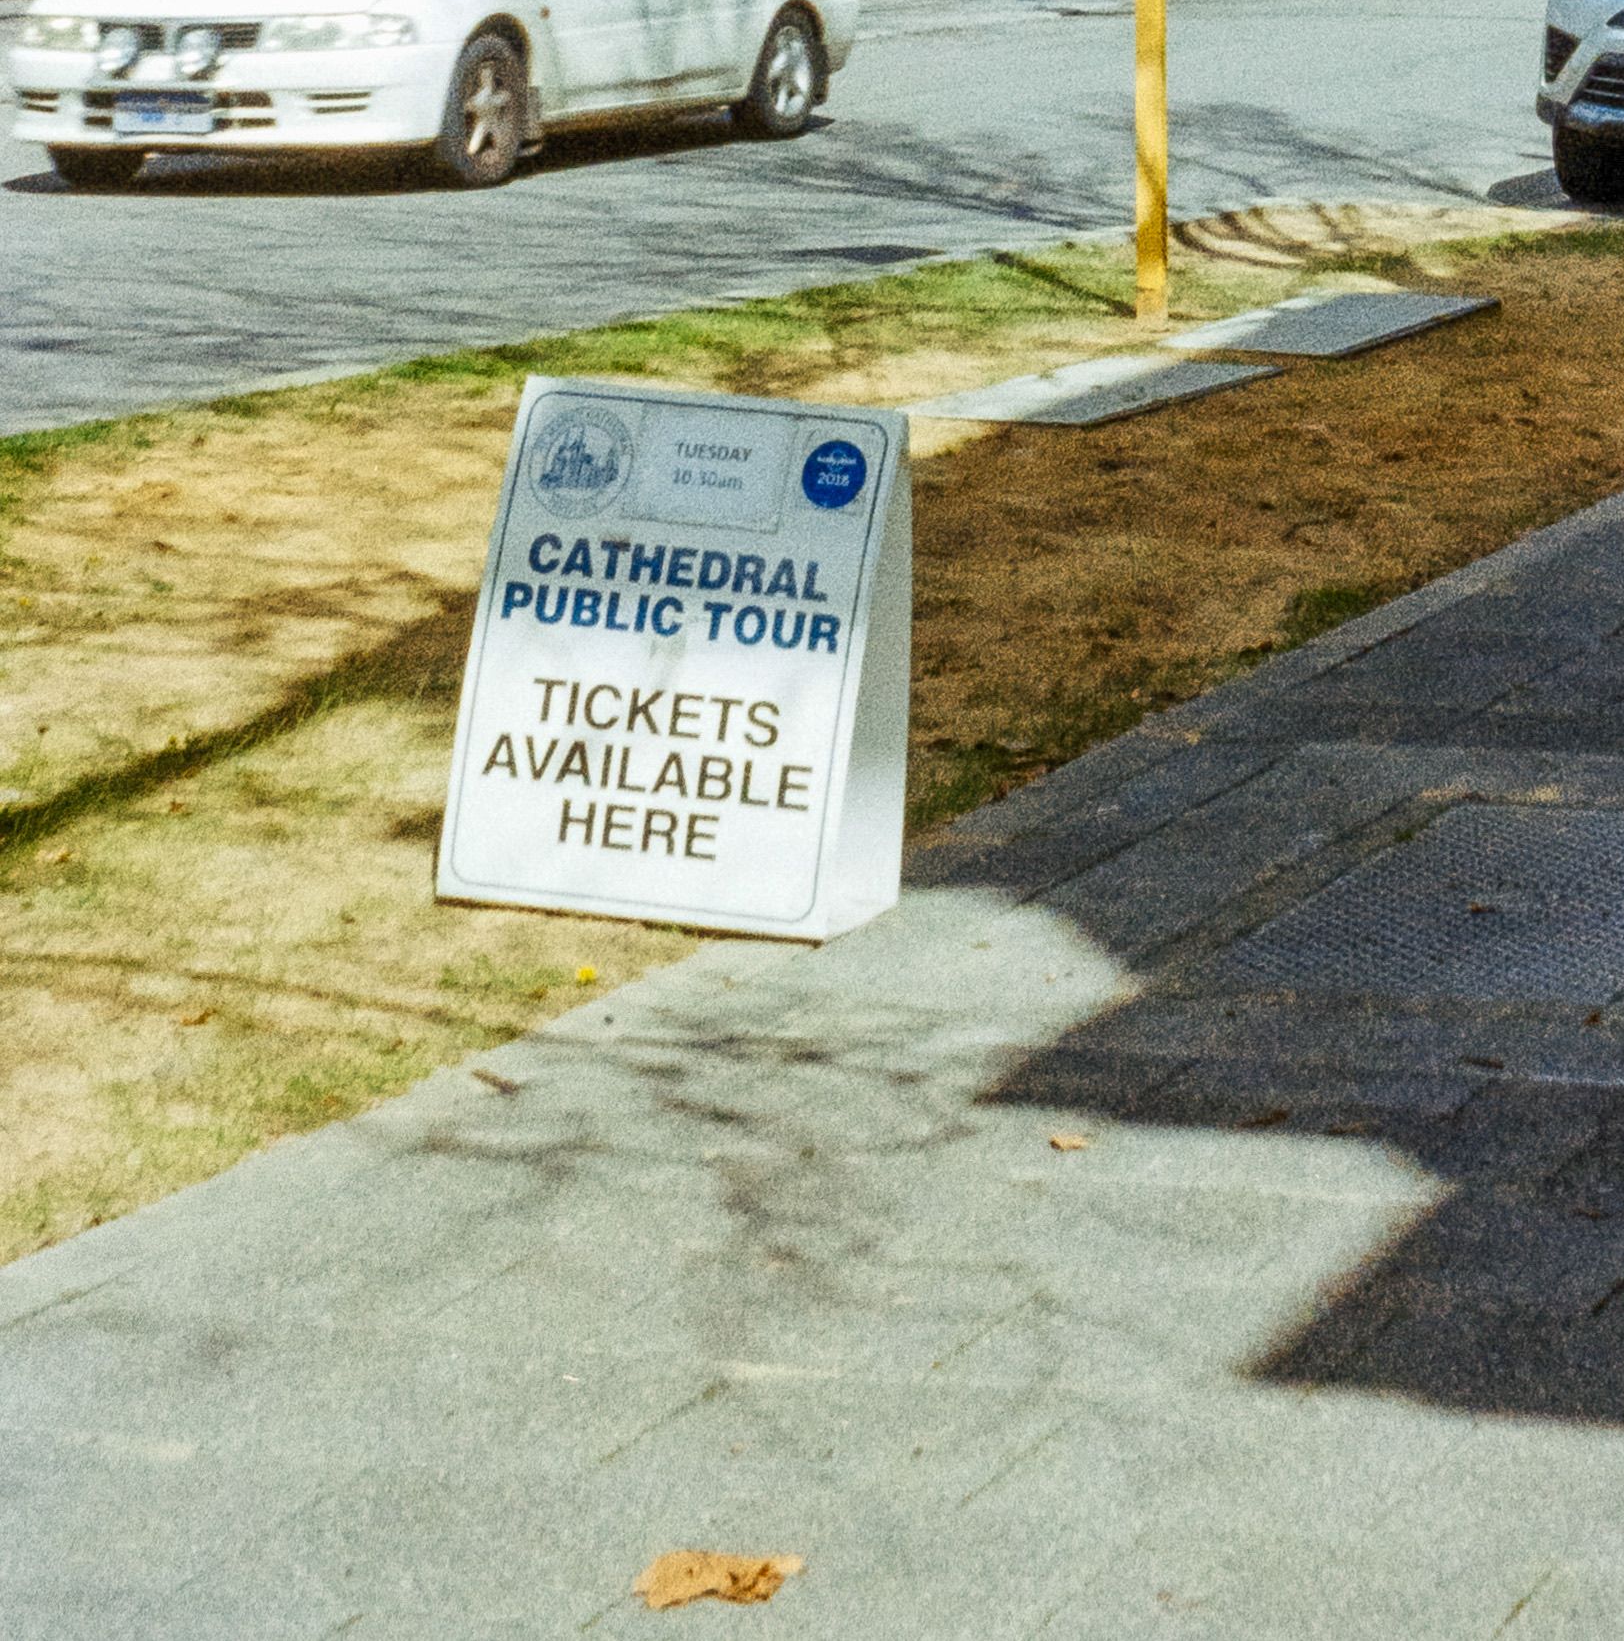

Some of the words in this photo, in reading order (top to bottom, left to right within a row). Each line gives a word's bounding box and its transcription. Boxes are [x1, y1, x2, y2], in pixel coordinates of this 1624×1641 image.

[675, 440, 752, 463] TUESDAY
[528, 533, 828, 602] CATHEDRAL
[500, 581, 684, 637] PUBLIC
[703, 601, 841, 654] TOUR
[533, 678, 780, 747] TICKETS
[481, 732, 813, 811] AVAILABLE
[558, 798, 720, 861] HERE
